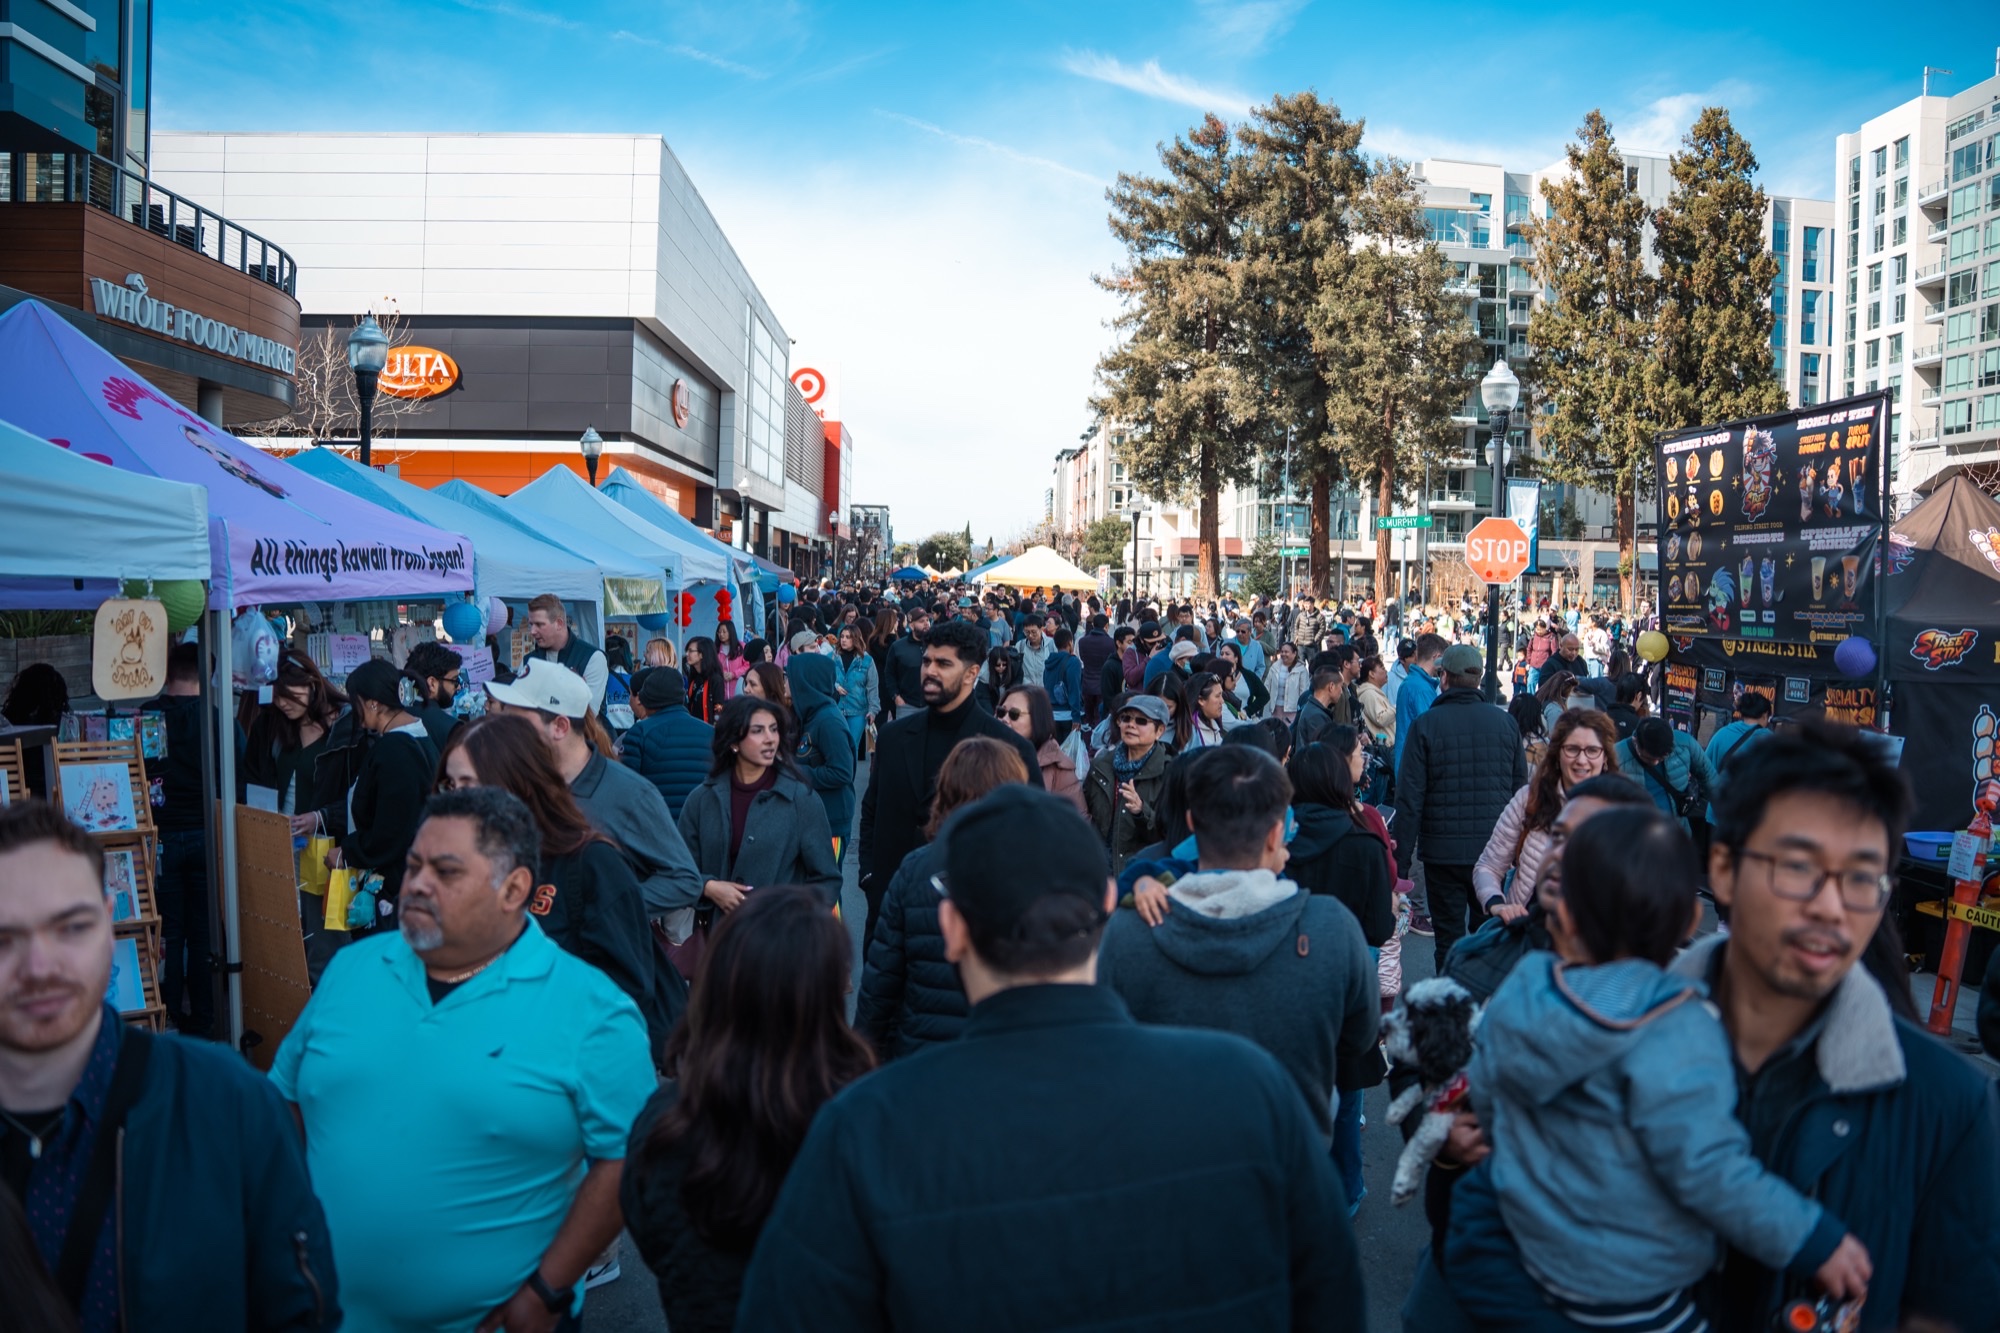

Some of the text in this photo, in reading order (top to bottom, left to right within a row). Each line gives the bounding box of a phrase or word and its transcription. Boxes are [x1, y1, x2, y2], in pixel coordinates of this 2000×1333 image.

[90, 274, 297, 376] WHOLE FOODS MARKET
[383, 353, 450, 377] ULTA
[1796, 406, 1875, 430] HOME OF THE
[1829, 431, 1840, 450] &
[1848, 424, 1870, 436] TURON
[1663, 432, 1731, 454] STREET FOOD
[1845, 433, 1871, 450] SPLIT
[1380, 519, 1384, 528] S
[1386, 517, 1418, 527] MURPHY
[1800, 525, 1871, 541] SPECIALTY
[1733, 532, 1785, 544] DESSERTS
[251, 537, 281, 577] All
[284, 538, 338, 583] things
[336, 538, 388, 573] kawaii
[1469, 537, 1527, 563] STOP
[116, 609, 135, 633] ART
[1741, 625, 1774, 637] HALO HALO
[1928, 646, 1964, 667] STIX
[112, 665, 149, 688] JULIA
[1789, 681, 1806, 689] ORDER
